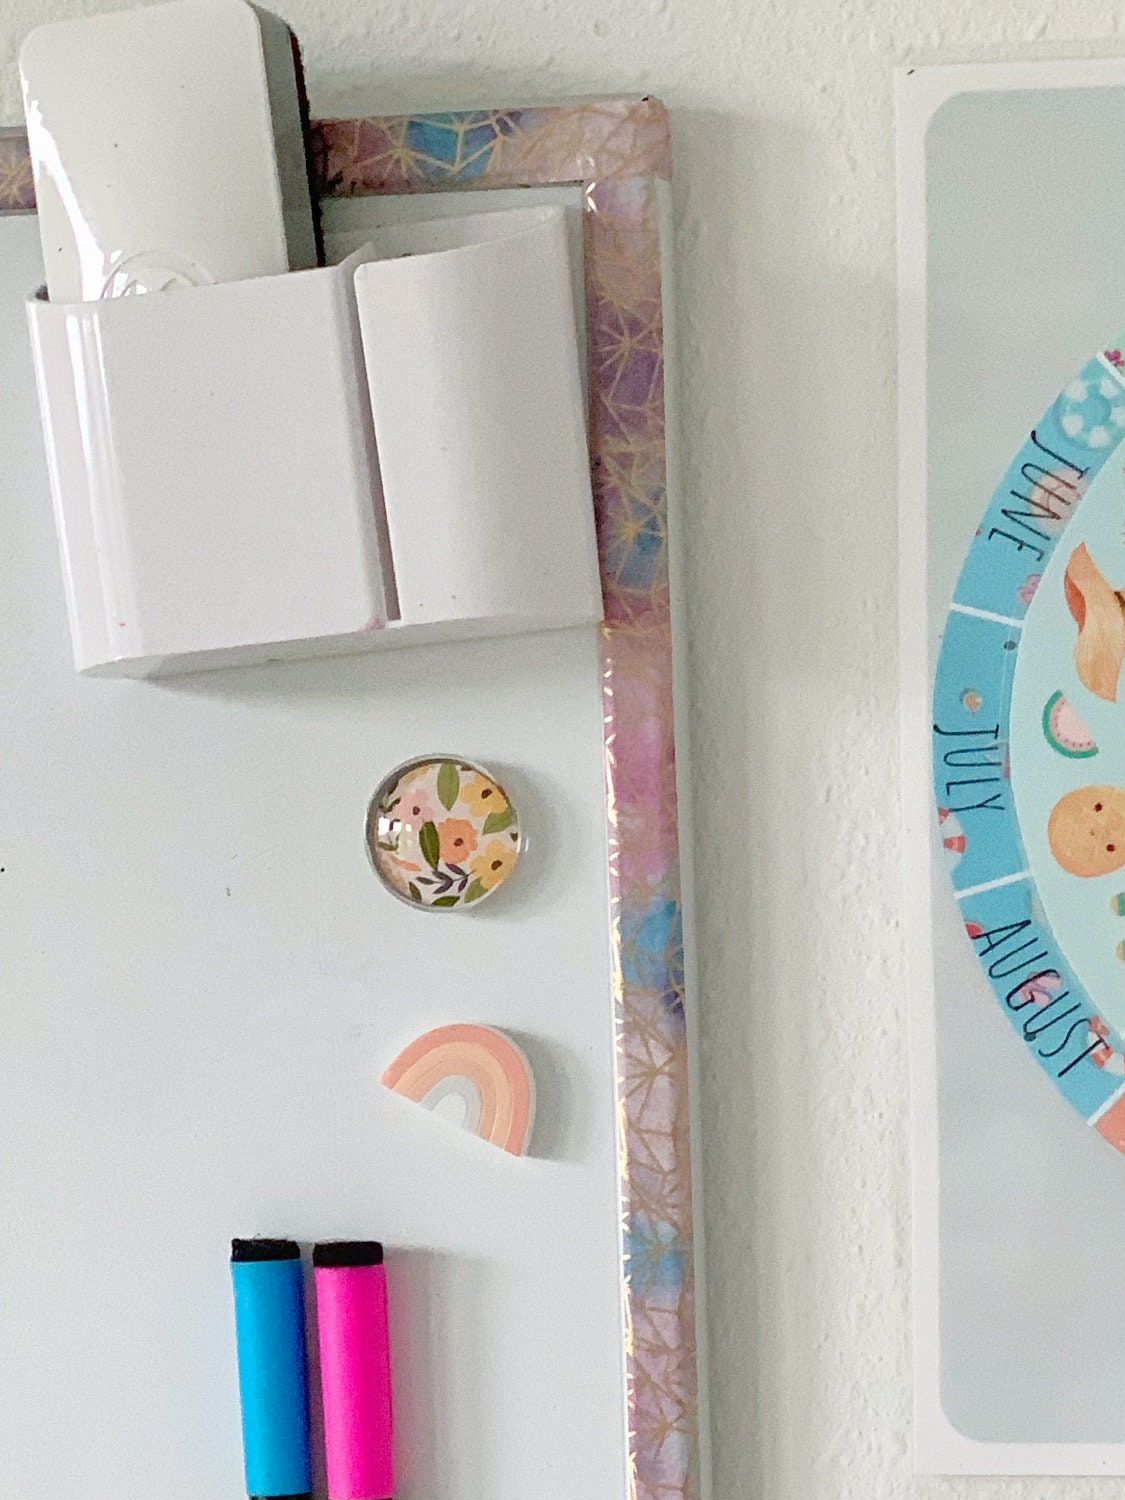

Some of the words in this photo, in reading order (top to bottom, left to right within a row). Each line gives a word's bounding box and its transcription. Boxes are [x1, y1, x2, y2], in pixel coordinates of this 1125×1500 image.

[987, 429, 1090, 562] JUNE
[932, 723, 1006, 814] JULY
[972, 918, 1107, 1079] AUGUST
